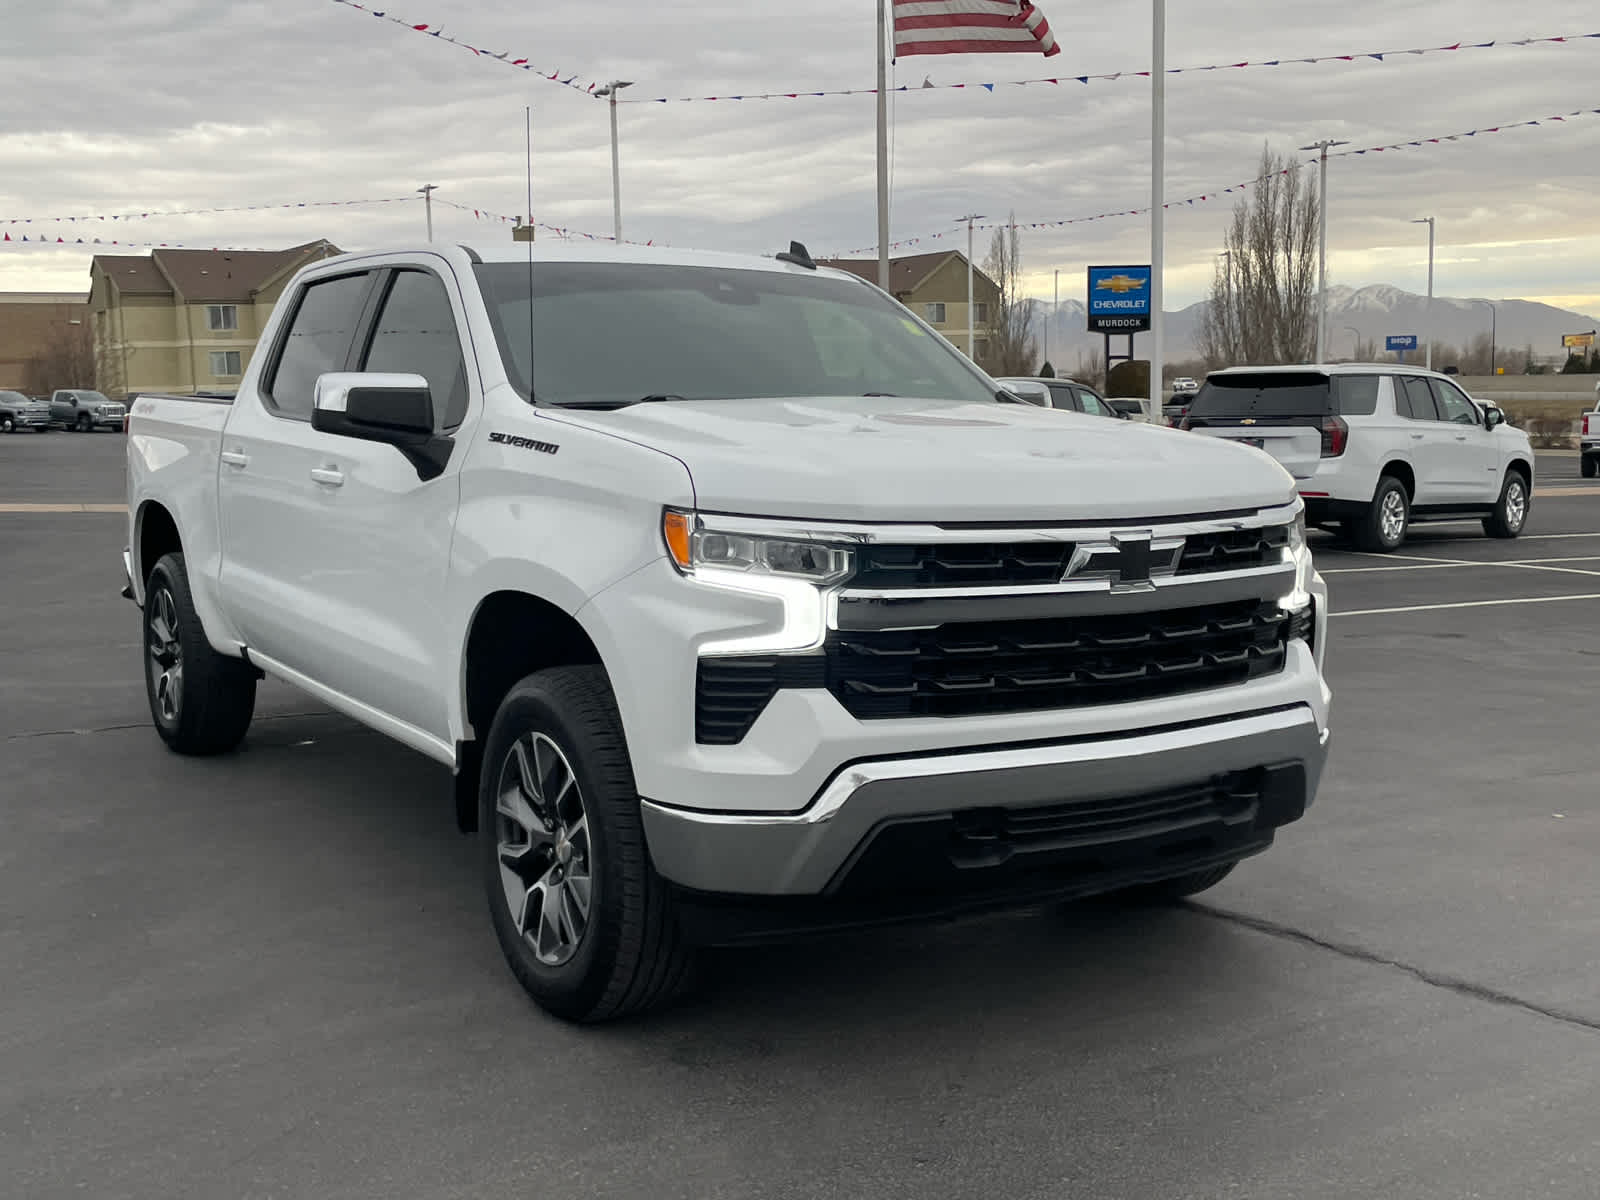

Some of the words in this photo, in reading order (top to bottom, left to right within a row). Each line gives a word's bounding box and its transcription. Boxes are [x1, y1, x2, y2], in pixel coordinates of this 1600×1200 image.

[1093, 300, 1146, 309] CHEVROLET
[1097, 319, 1141, 327] MURDOCK
[488, 432, 560, 455] SILVERADO
